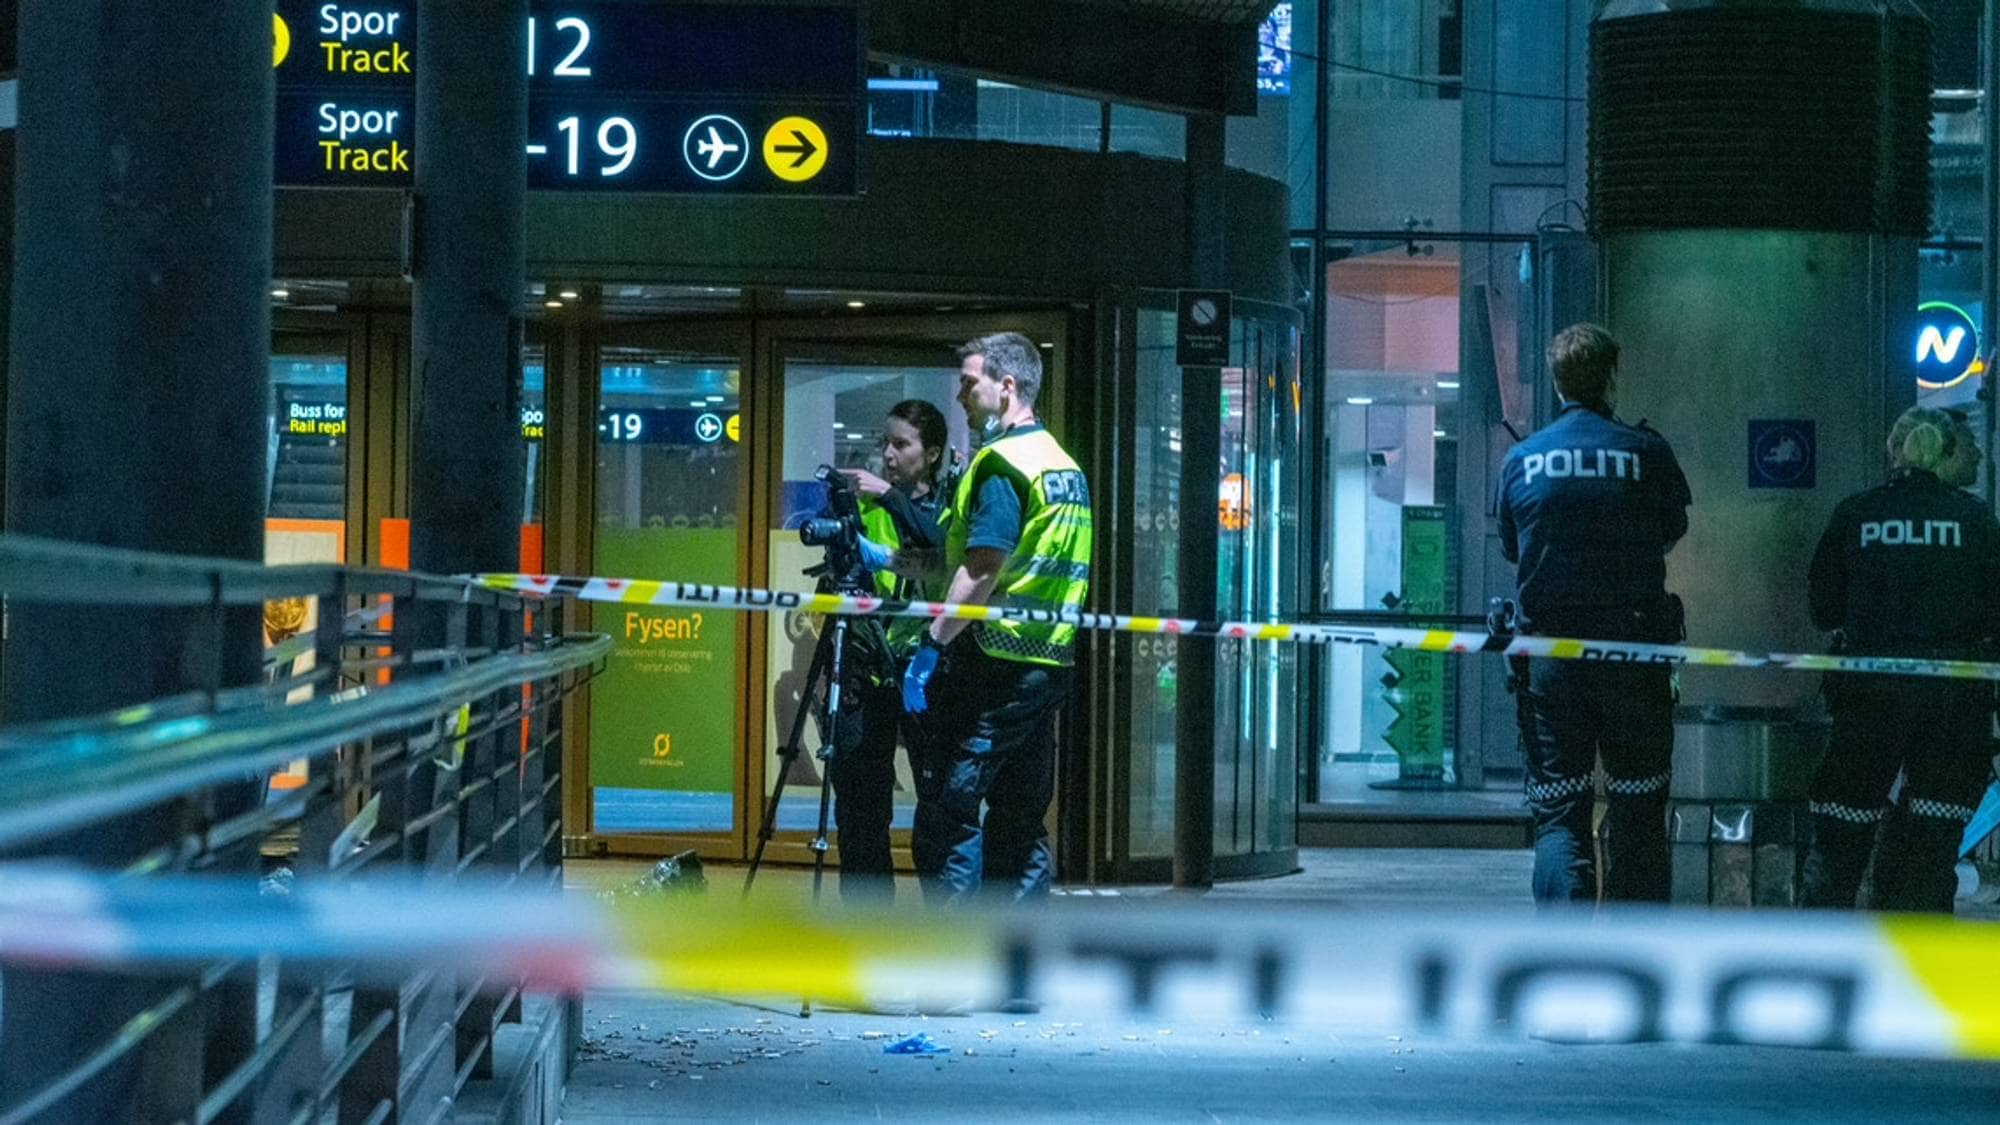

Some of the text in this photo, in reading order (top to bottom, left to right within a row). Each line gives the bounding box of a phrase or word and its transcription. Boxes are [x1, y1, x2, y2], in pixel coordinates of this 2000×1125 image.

[320, 4, 399, 41] Spor
[320, 42, 411, 73] Track
[319, 103, 398, 140] Spor
[319, 141, 409, 171] Track
[526, 117, 637, 176] -19
[1917, 327, 1965, 363] N
[290, 419, 315, 433] Rail
[291, 403, 345, 418] Buss for
[1524, 448, 1639, 484] POLITI
[1861, 520, 1960, 547] POLITI
[626, 612, 702, 643] Fysen?
[1414, 692, 1432, 755] BANK
